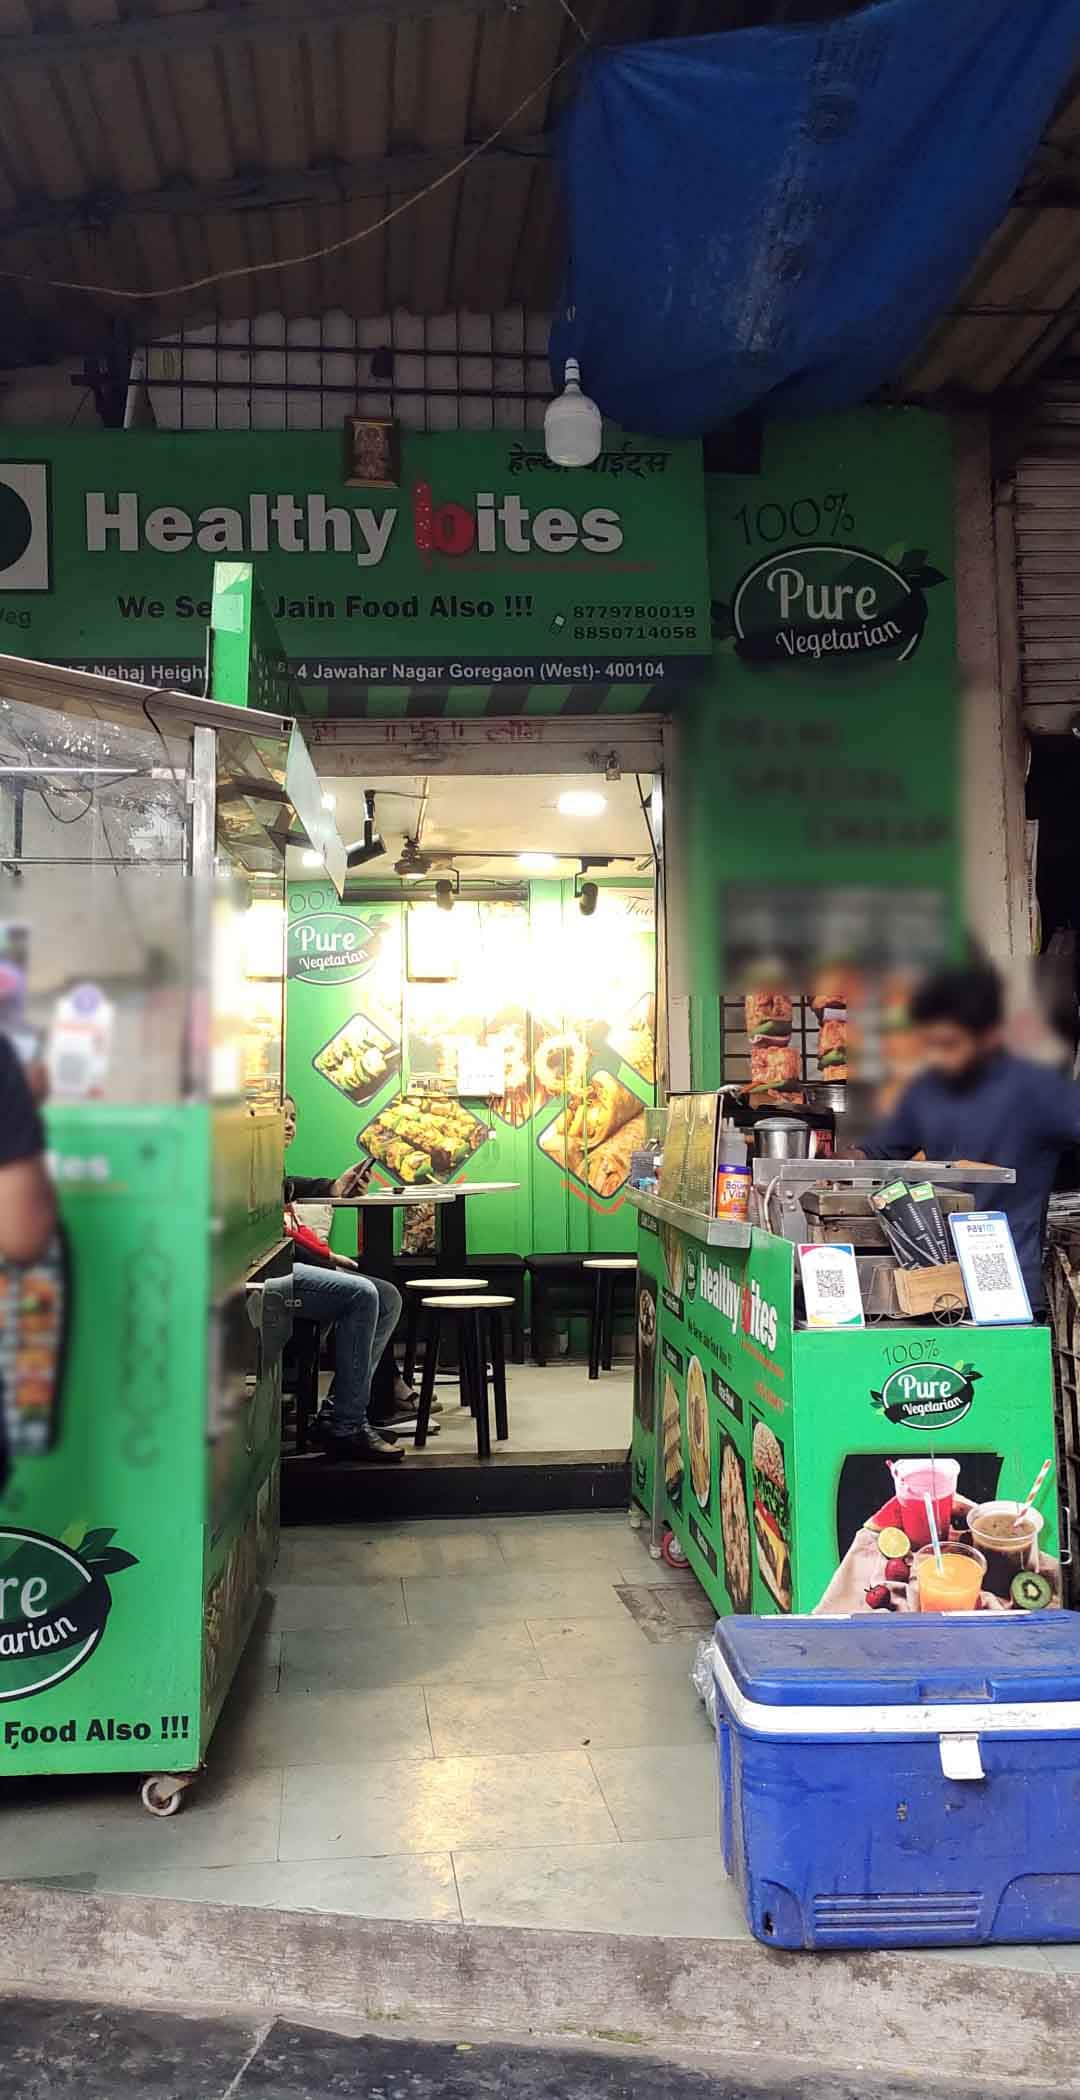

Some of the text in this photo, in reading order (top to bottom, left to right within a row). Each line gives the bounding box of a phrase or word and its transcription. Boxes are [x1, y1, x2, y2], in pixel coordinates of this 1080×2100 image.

[86, 480, 624, 566] Healthy bites
[735, 491, 855, 546] 100%
[117, 595, 165, 618] We
[272, 595, 336, 618] Jain
[346, 595, 418, 618] Food
[430, 595, 495, 618] Also
[504, 595, 534, 617] !!!
[767, 567, 879, 621] Pure
[0, 607, 32, 628] eg
[573, 605, 696, 619] 8779780019
[573, 626, 697, 640] 8850714058
[776, 619, 902, 659] Vegetarian
[313, 664, 387, 679] Jawahar
[392, 664, 444, 681] Nagar
[450, 663, 534, 681] Goregaon
[605, 663, 664, 677] 400104
[294, 925, 355, 952] Pure
[299, 949, 369, 970] Vegetarian
[700, 1251, 741, 1335] Healthy
[882, 1338, 941, 1366] 100%
[897, 1373, 952, 1399] Pure
[902, 1396, 964, 1416] Vegetarian
[0, 1576, 48, 1620] re
[0, 1616, 78, 1655] arian
[5, 1715, 190, 1744] Food Also !!!
